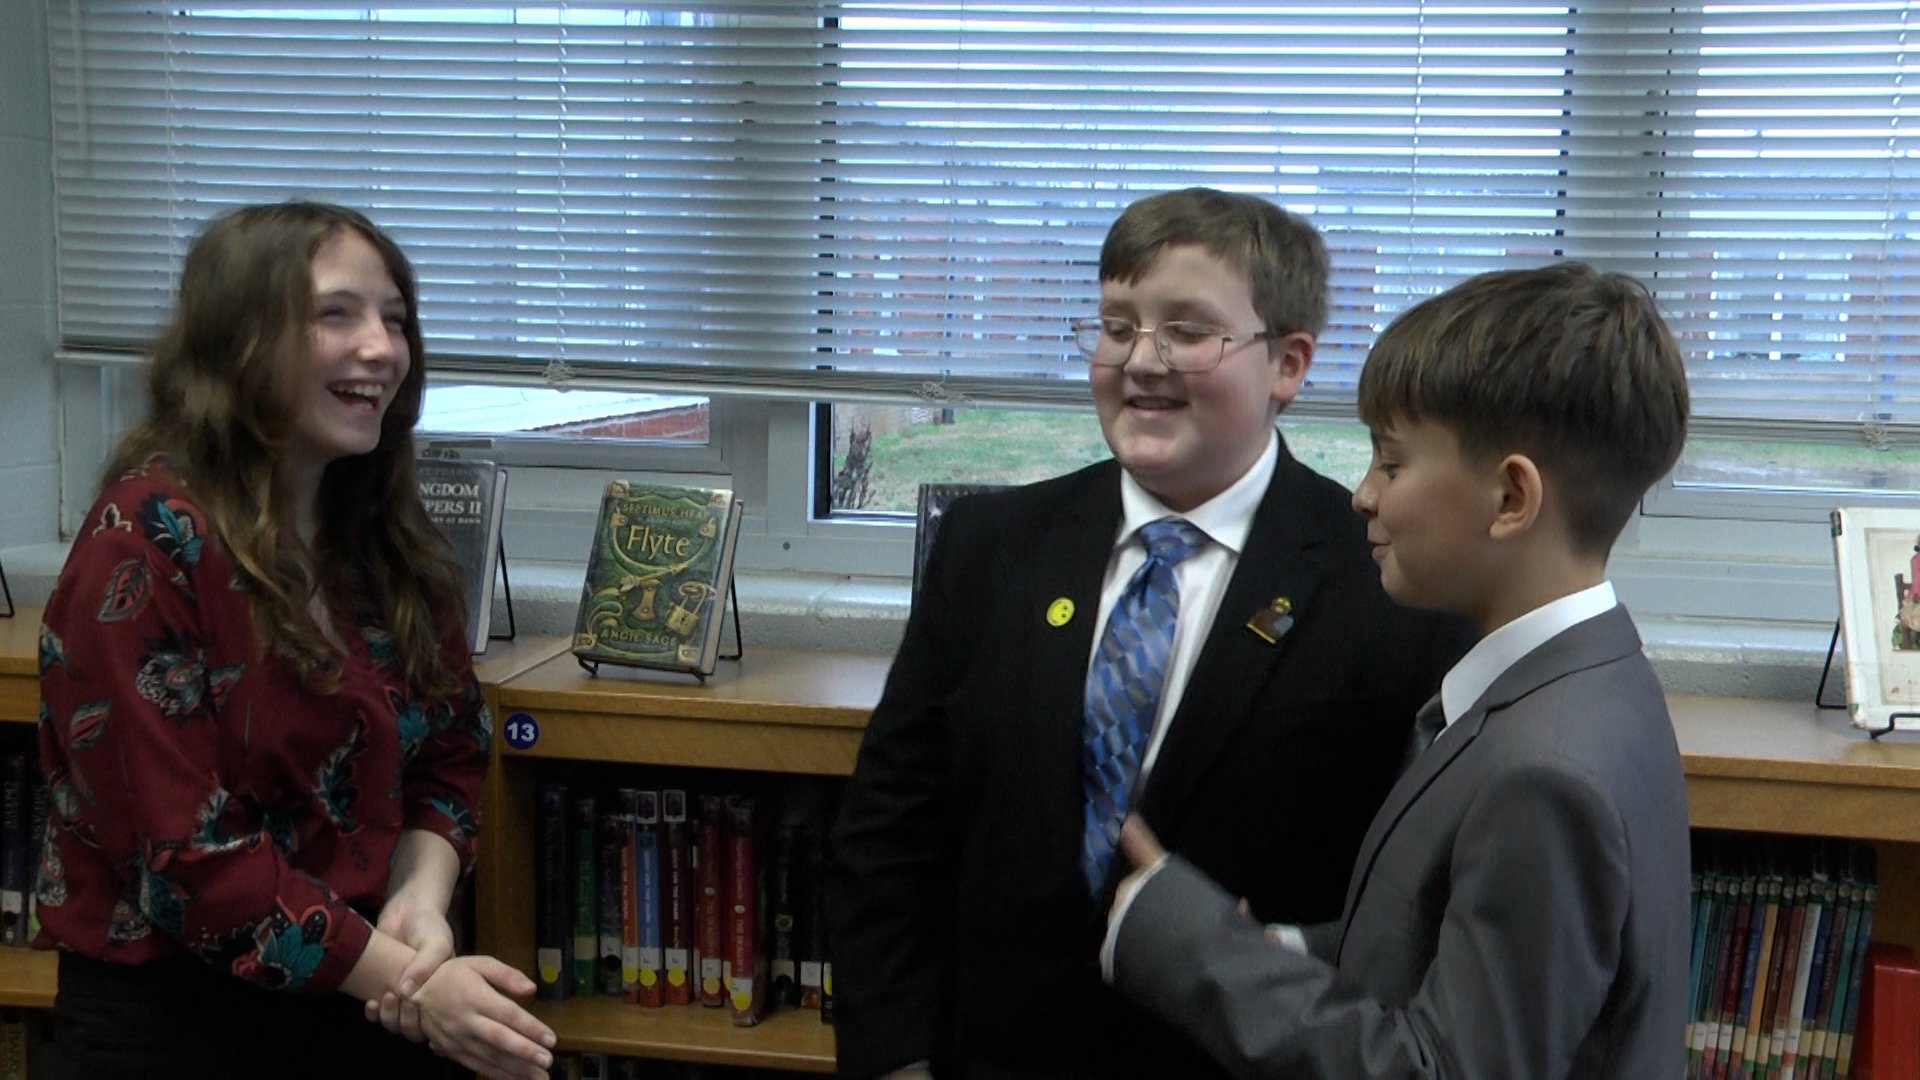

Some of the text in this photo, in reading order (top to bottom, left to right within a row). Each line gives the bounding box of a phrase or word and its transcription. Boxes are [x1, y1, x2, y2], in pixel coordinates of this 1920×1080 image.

[418, 481, 480, 497] NGDOM
[425, 500, 465, 514] PERS
[626, 524, 691, 560] Flyte
[599, 629, 679, 646] ANGIE SAGE
[507, 721, 535, 742] 13
